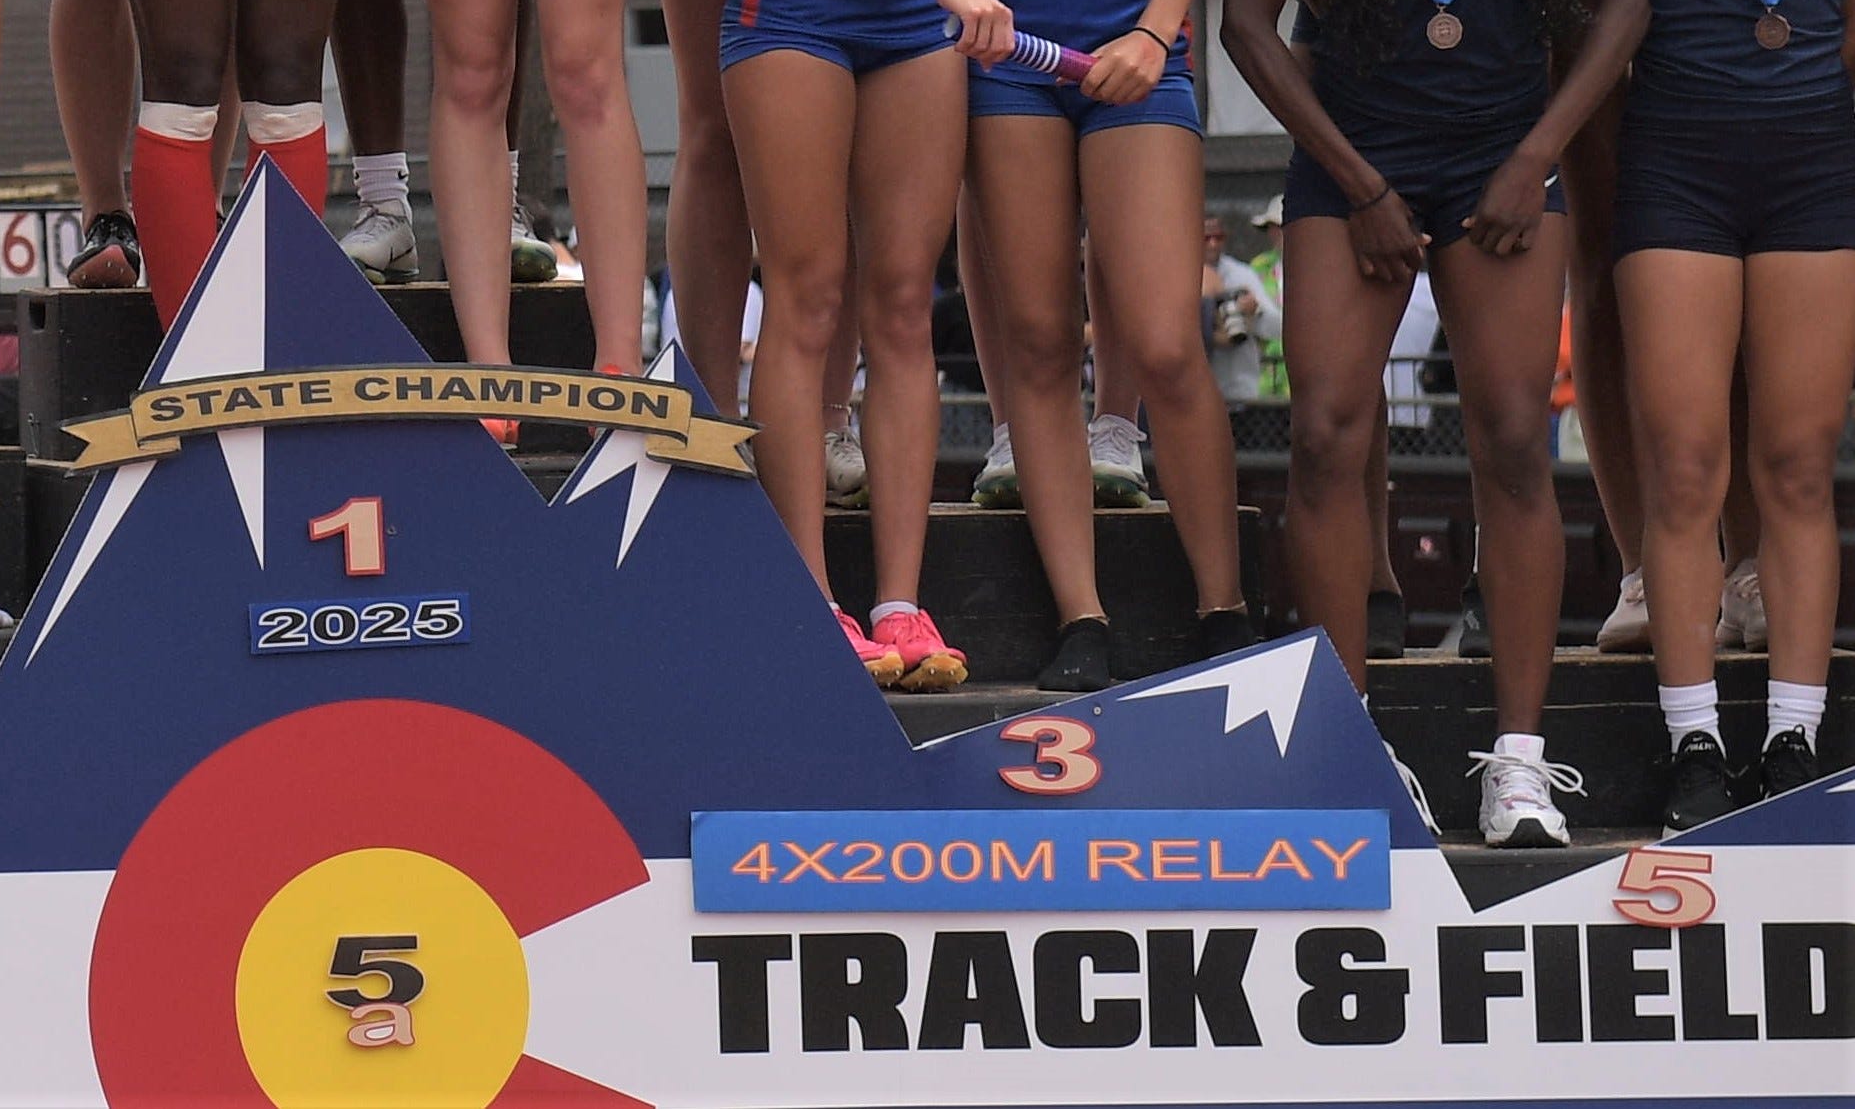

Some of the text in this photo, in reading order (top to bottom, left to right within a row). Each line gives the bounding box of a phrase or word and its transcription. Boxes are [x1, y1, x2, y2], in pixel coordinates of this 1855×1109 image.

[150, 375, 670, 423] STATE CHAMPION
[308, 497, 386, 577] 1
[257, 599, 464, 649] 2025
[998, 716, 1103, 795] 3
[730, 837, 1372, 884] 4X200M RELAY
[1612, 847, 1717, 929] 5
[325, 935, 426, 1010] 5
[691, 922, 1855, 1054] TRACK & FIELD
[347, 1002, 417, 1048] a
